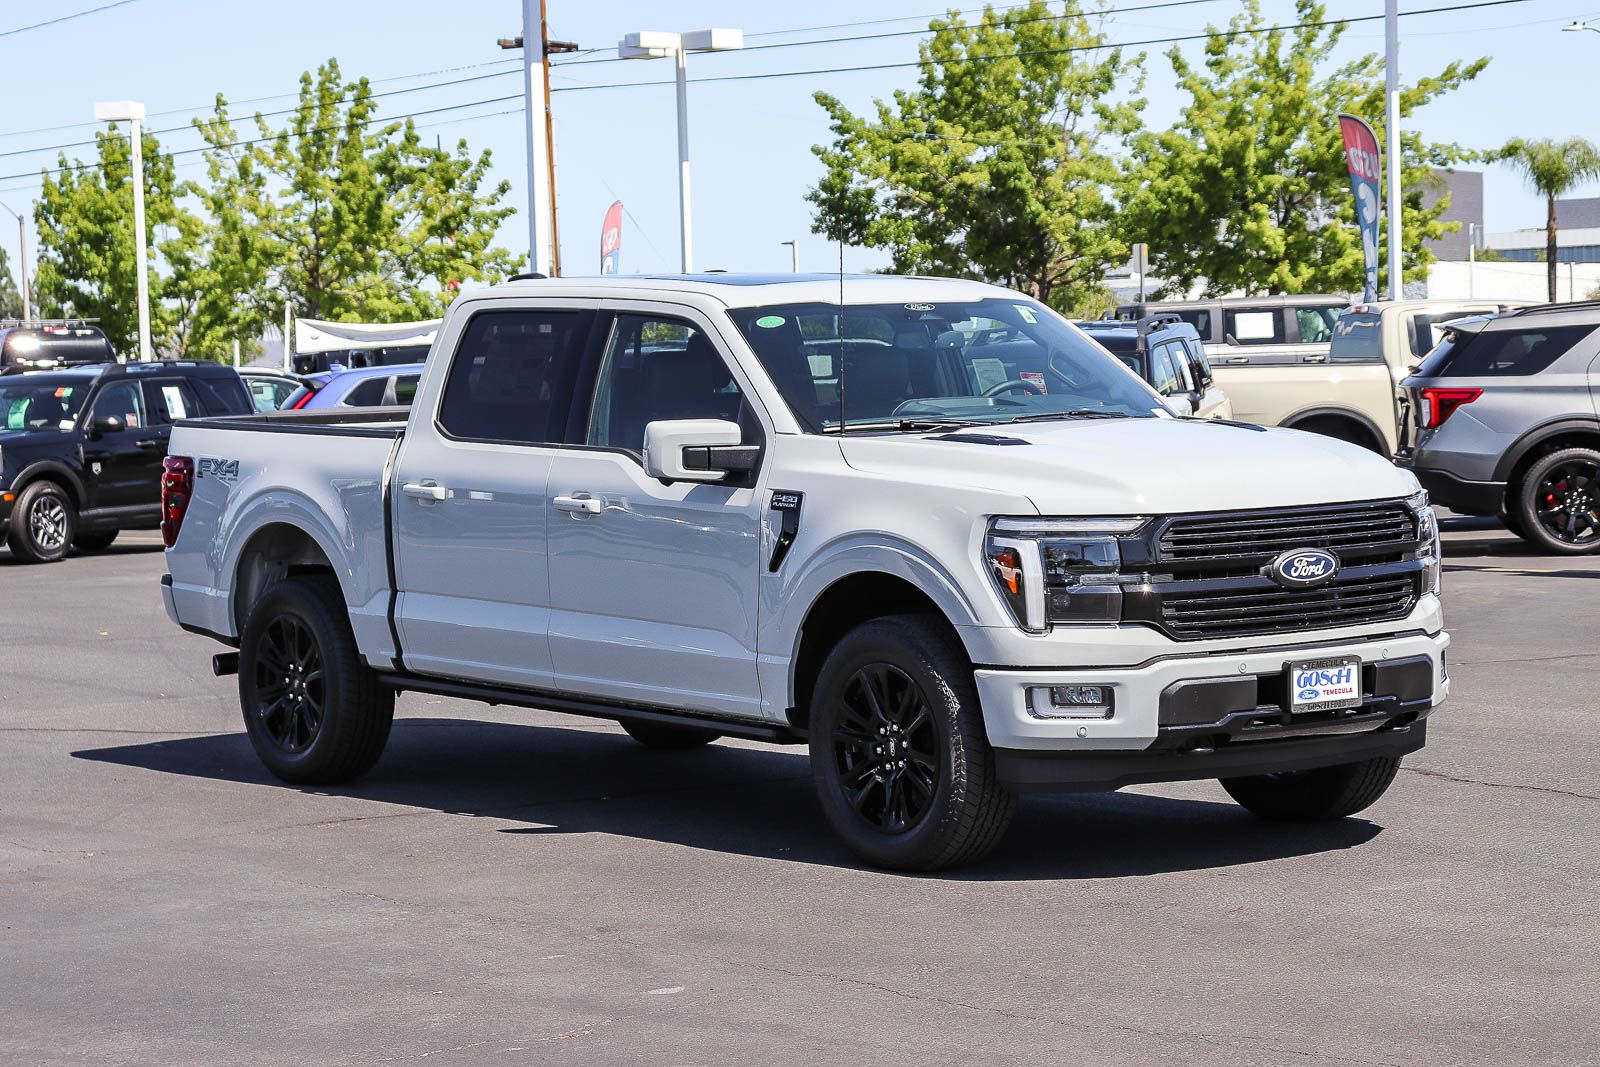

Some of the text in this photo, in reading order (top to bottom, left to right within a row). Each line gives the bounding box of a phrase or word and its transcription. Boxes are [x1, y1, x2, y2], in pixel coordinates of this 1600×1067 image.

[197, 457, 240, 478] FX4
[1290, 556, 1326, 577] Ford
[1307, 659, 1345, 669] TEMECULA
[1322, 687, 1353, 696] TEMECULA
